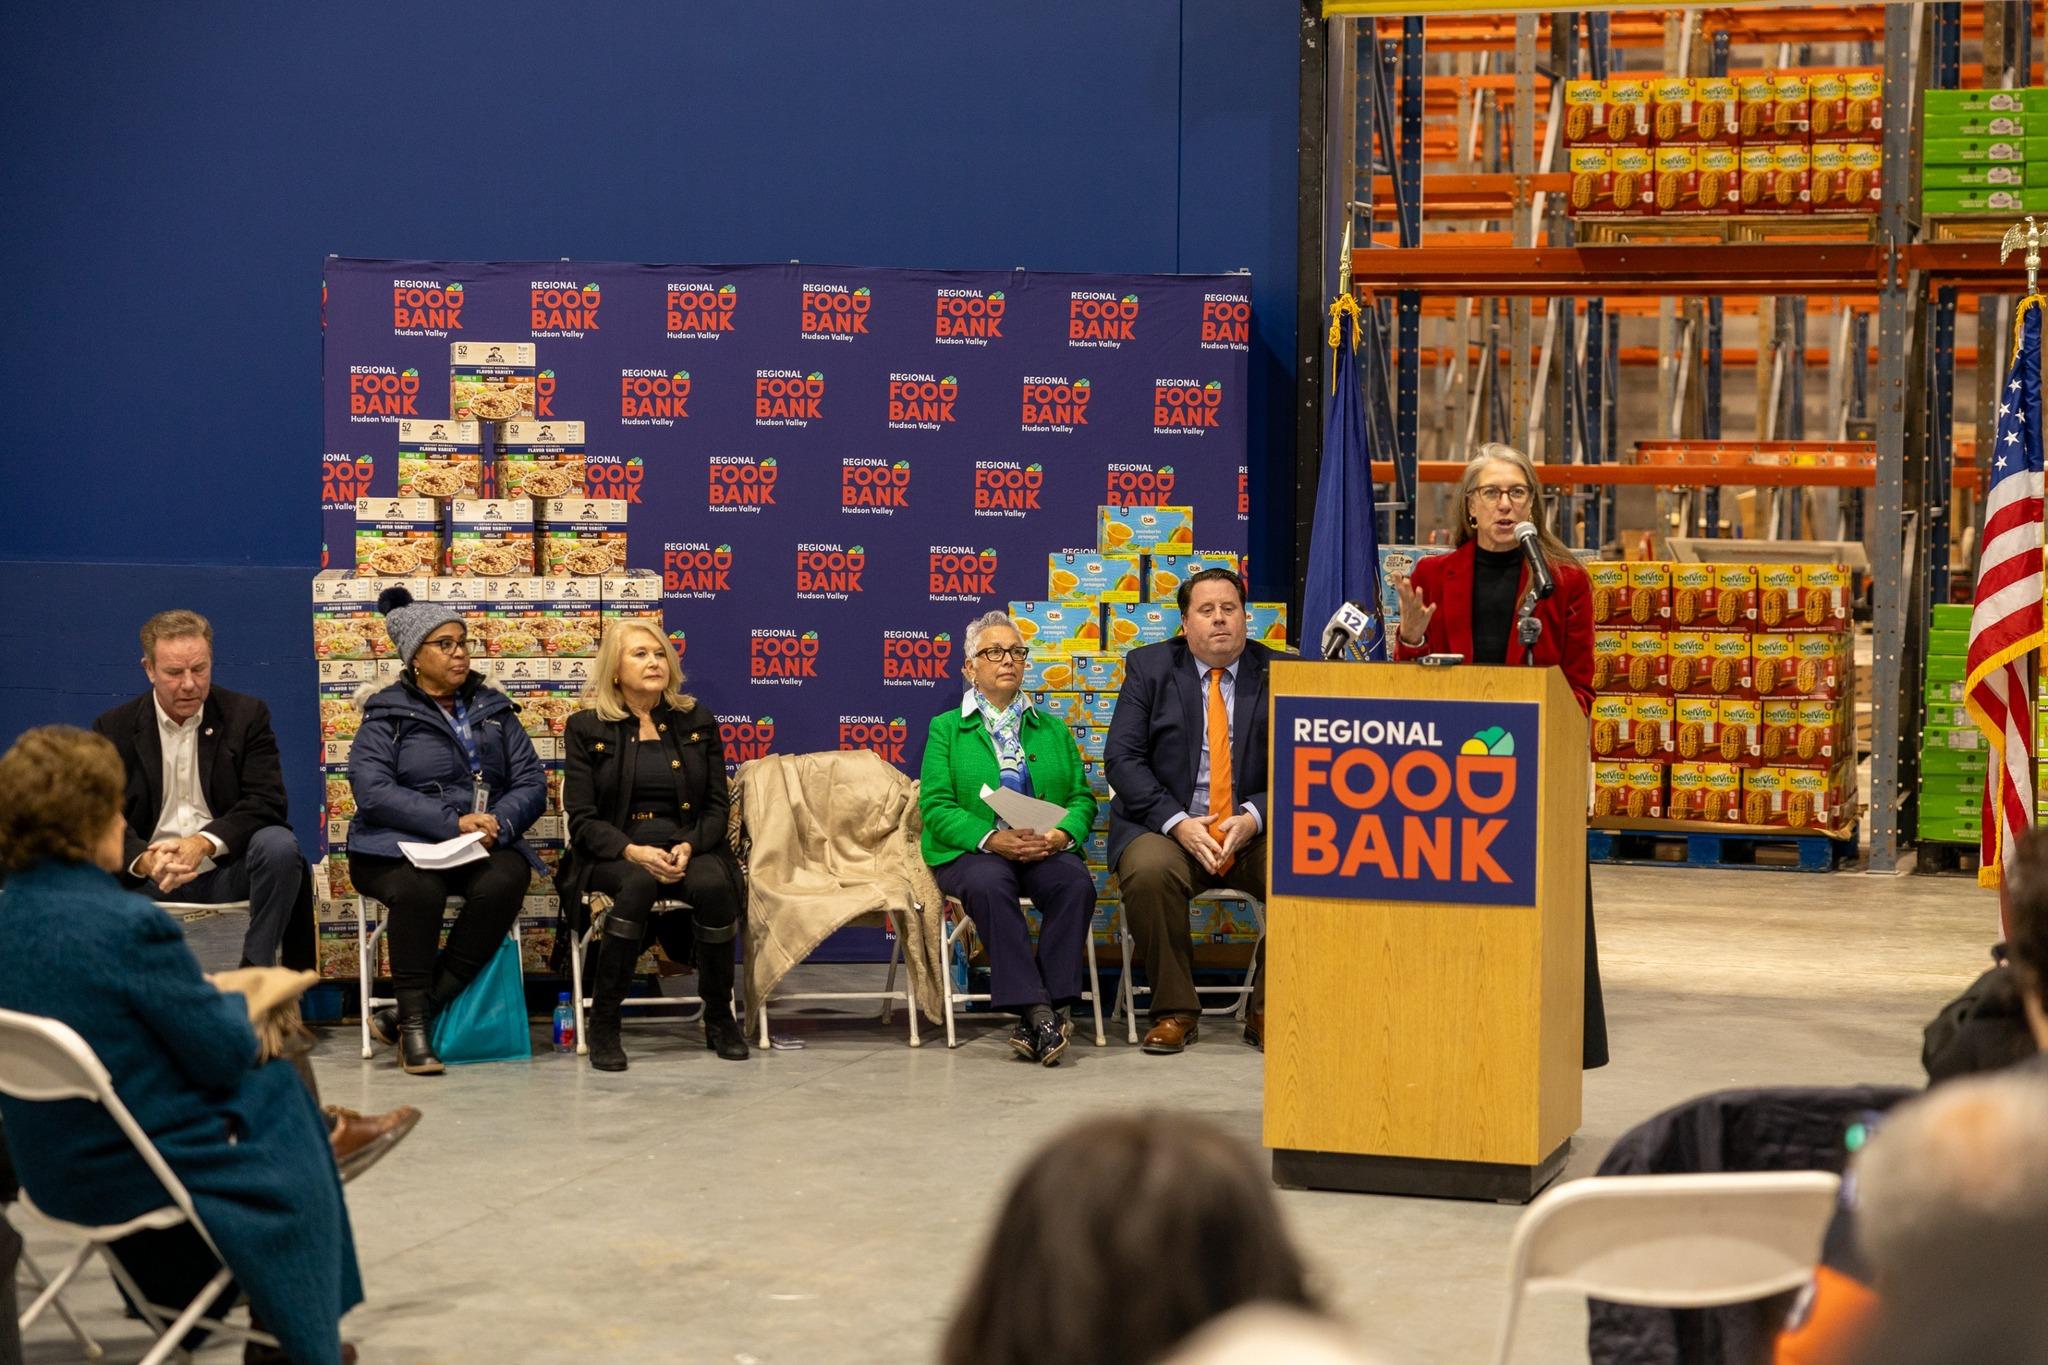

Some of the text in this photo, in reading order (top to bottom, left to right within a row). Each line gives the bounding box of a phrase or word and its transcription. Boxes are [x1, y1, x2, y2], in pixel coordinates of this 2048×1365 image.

[394, 280, 442, 289] REGIONAL
[532, 280, 578, 290] REGIONAL
[668, 284, 714, 292] REGIONAL
[802, 284, 848, 294] REGIONAL
[394, 288, 464, 308] FOOD
[938, 288, 984, 298] REGIONAL
[1072, 292, 1116, 301] REGIONAL
[531, 290, 601, 309] FOOD
[668, 292, 736, 310] FOOD
[803, 292, 871, 312] FOOD
[937, 298, 1005, 317] FOOD
[1071, 300, 1138, 319] FOOD
[394, 308, 462, 329] BANK
[532, 309, 599, 329] BANK
[667, 310, 734, 331] BANK
[802, 312, 868, 333] BANK
[936, 317, 1002, 336] BANK
[1070, 319, 1135, 339] BANK
[395, 329, 448, 339] Hudson Valley
[532, 330, 584, 340] Hudson Valley
[667, 331, 720, 341] Hudson Valley
[802, 333, 853, 342] Hudson Valley
[936, 337, 987, 346] Hudson Valley
[1069, 340, 1120, 350] Hudson Valley
[458, 346, 467, 354] 52
[622, 368, 668, 378] REGIONAL
[756, 370, 802, 378] REGIONAL
[890, 372, 936, 382] REGIONAL
[1024, 376, 1068, 385] REGIONAL
[1156, 378, 1200, 388] REGIONAL
[622, 378, 690, 396] FOOD
[756, 379, 824, 397] FOOD
[890, 382, 957, 400] FOOD
[1023, 385, 1090, 404] FOOD
[1155, 387, 1221, 406] FOOD
[622, 396, 688, 416] BANK
[756, 397, 821, 418] BANK
[889, 400, 955, 421] BANK
[1022, 404, 1088, 424] BANK
[1154, 406, 1218, 426] BANK
[402, 422, 411, 432] 52
[622, 418, 673, 428] Hudson Valley
[785, 419, 807, 428] Valley
[889, 422, 940, 432] Hudson Valley
[510, 424, 519, 434] 52
[1051, 425, 1073, 434] Valley
[1154, 427, 1204, 436] Hudson Valley
[710, 456, 756, 465] REGIONAL
[842, 458, 888, 467] REGIONAL
[976, 460, 1022, 470] REGIONAL
[710, 465, 777, 483] FOOD
[843, 467, 910, 485] FOOD
[976, 470, 1043, 488] FOOD
[710, 483, 775, 504] BANK
[842, 485, 908, 506] BANK
[975, 488, 1040, 509] BANK
[359, 501, 368, 510] 52
[456, 502, 464, 512] 52
[554, 502, 563, 512] 52
[842, 507, 893, 516] Hudson Valley
[1004, 510, 1026, 518] Valley
[664, 542, 710, 551] REGIONAL
[798, 544, 842, 552] REGIONAL
[930, 546, 976, 555] REGIONAL
[665, 551, 732, 570] FOOD
[797, 552, 864, 571] FOOD
[930, 554, 997, 573] FOOD
[664, 570, 729, 590] BANK
[797, 571, 862, 591] BANK
[1593, 572, 1622, 581] belVita
[1634, 572, 1664, 581] belVita
[1678, 572, 1708, 582] belVita
[1720, 573, 1751, 582] belVita
[1764, 573, 1795, 582] belVita
[1808, 572, 1839, 582] belVita
[316, 584, 324, 592] 52
[488, 582, 498, 592] 52
[546, 581, 555, 590] 52
[930, 573, 995, 593] BANK
[692, 592, 716, 600] Valley
[826, 592, 848, 600] Valley
[959, 595, 980, 604] Valley
[1344, 611, 1362, 632] 12
[752, 630, 796, 638] REGIONAL
[884, 630, 930, 639] REGIONAL
[752, 638, 818, 656] FOOD
[884, 639, 951, 658] FOOD
[1632, 640, 1662, 648] belVita
[1674, 640, 1704, 650] belVita
[1715, 641, 1744, 650] belVita
[322, 664, 331, 672] 52
[752, 657, 817, 676] BANK
[884, 658, 949, 678] BANK
[780, 678, 802, 686] Valley
[913, 679, 935, 688] Valley
[1596, 704, 1627, 714] belVita
[1637, 705, 1668, 715] belVita
[1682, 707, 1712, 717] belVita
[1800, 710, 1830, 720] belVita
[1294, 718, 1442, 746] REGIONAL
[1293, 746, 1517, 814] FOOD
[1596, 770, 1626, 780] belVita
[1628, 772, 1658, 782] belVita
[1672, 772, 1702, 782] belVita
[331, 824, 340, 832] 52
[1292, 811, 1514, 883] BANK
